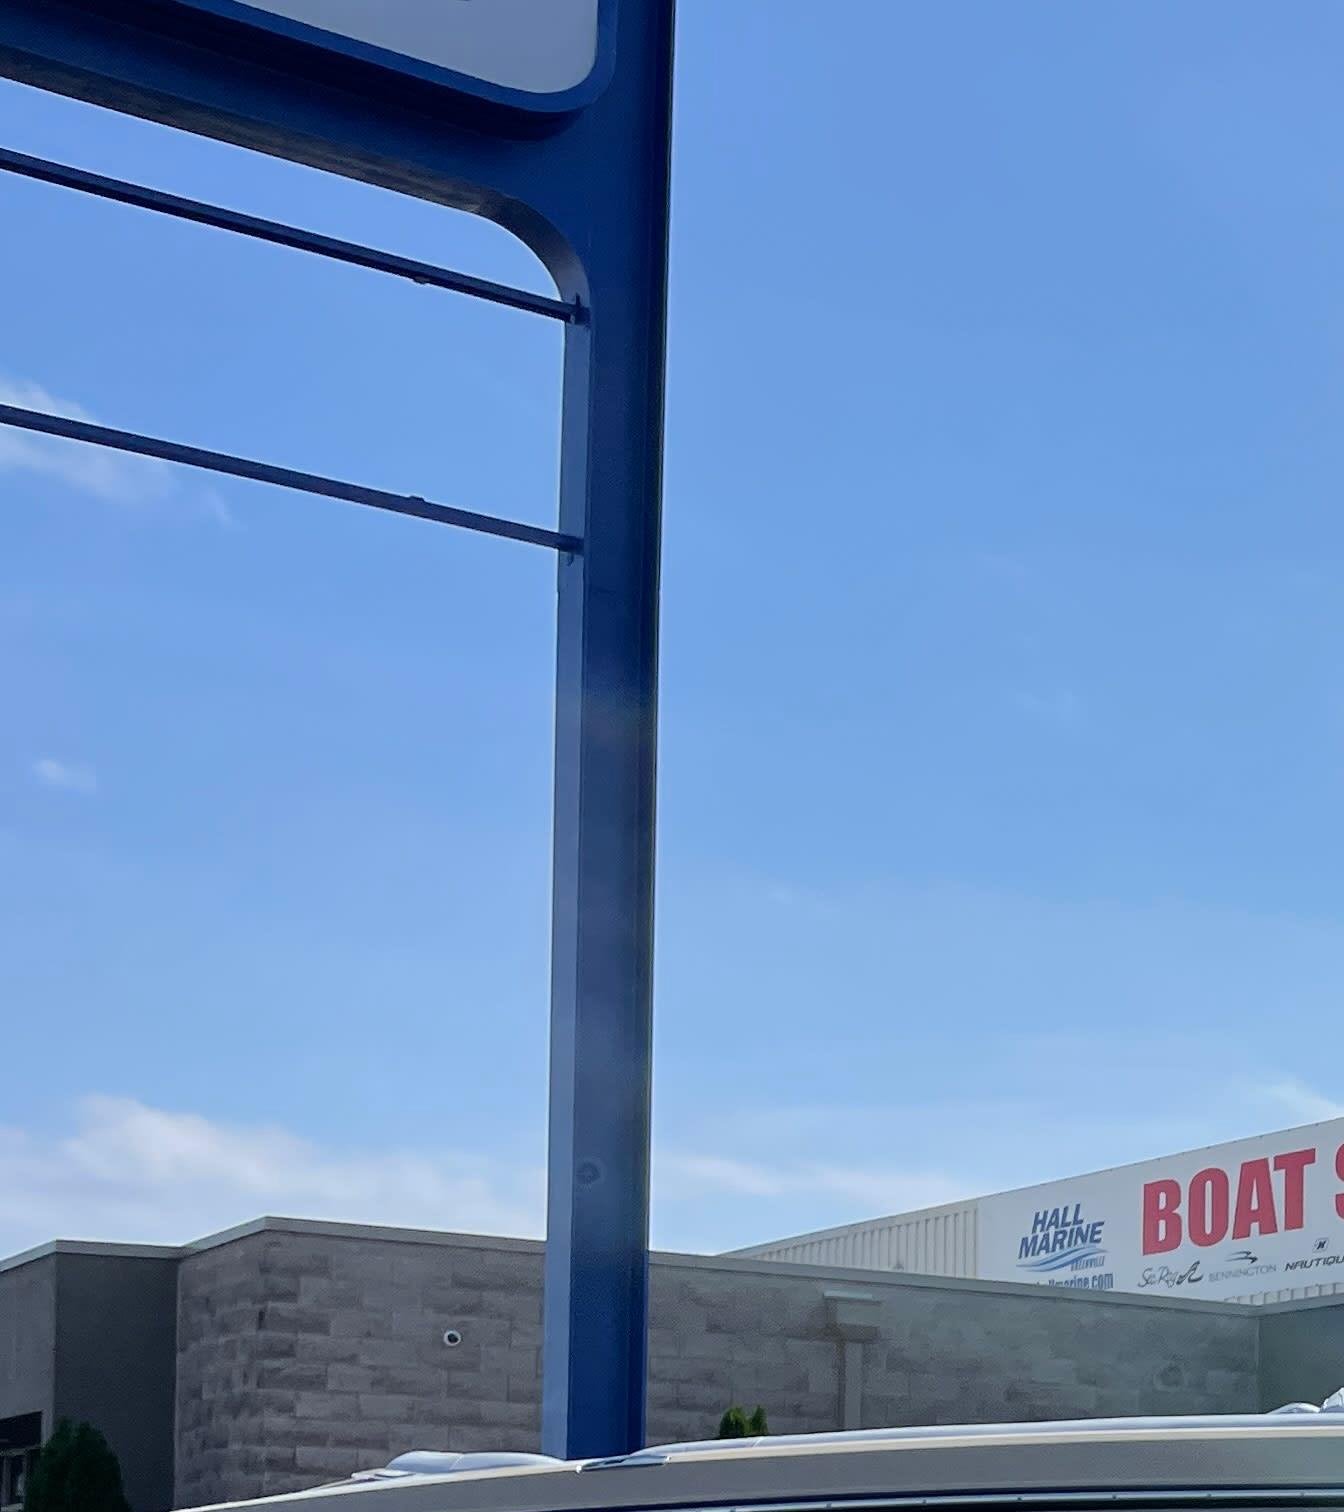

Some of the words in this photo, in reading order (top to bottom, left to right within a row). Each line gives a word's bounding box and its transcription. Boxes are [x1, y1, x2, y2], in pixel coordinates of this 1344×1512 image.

[1031, 1203, 1084, 1234] HALL
[1142, 1148, 1317, 1256] BOAT
[1018, 1221, 1105, 1259] MARINE
